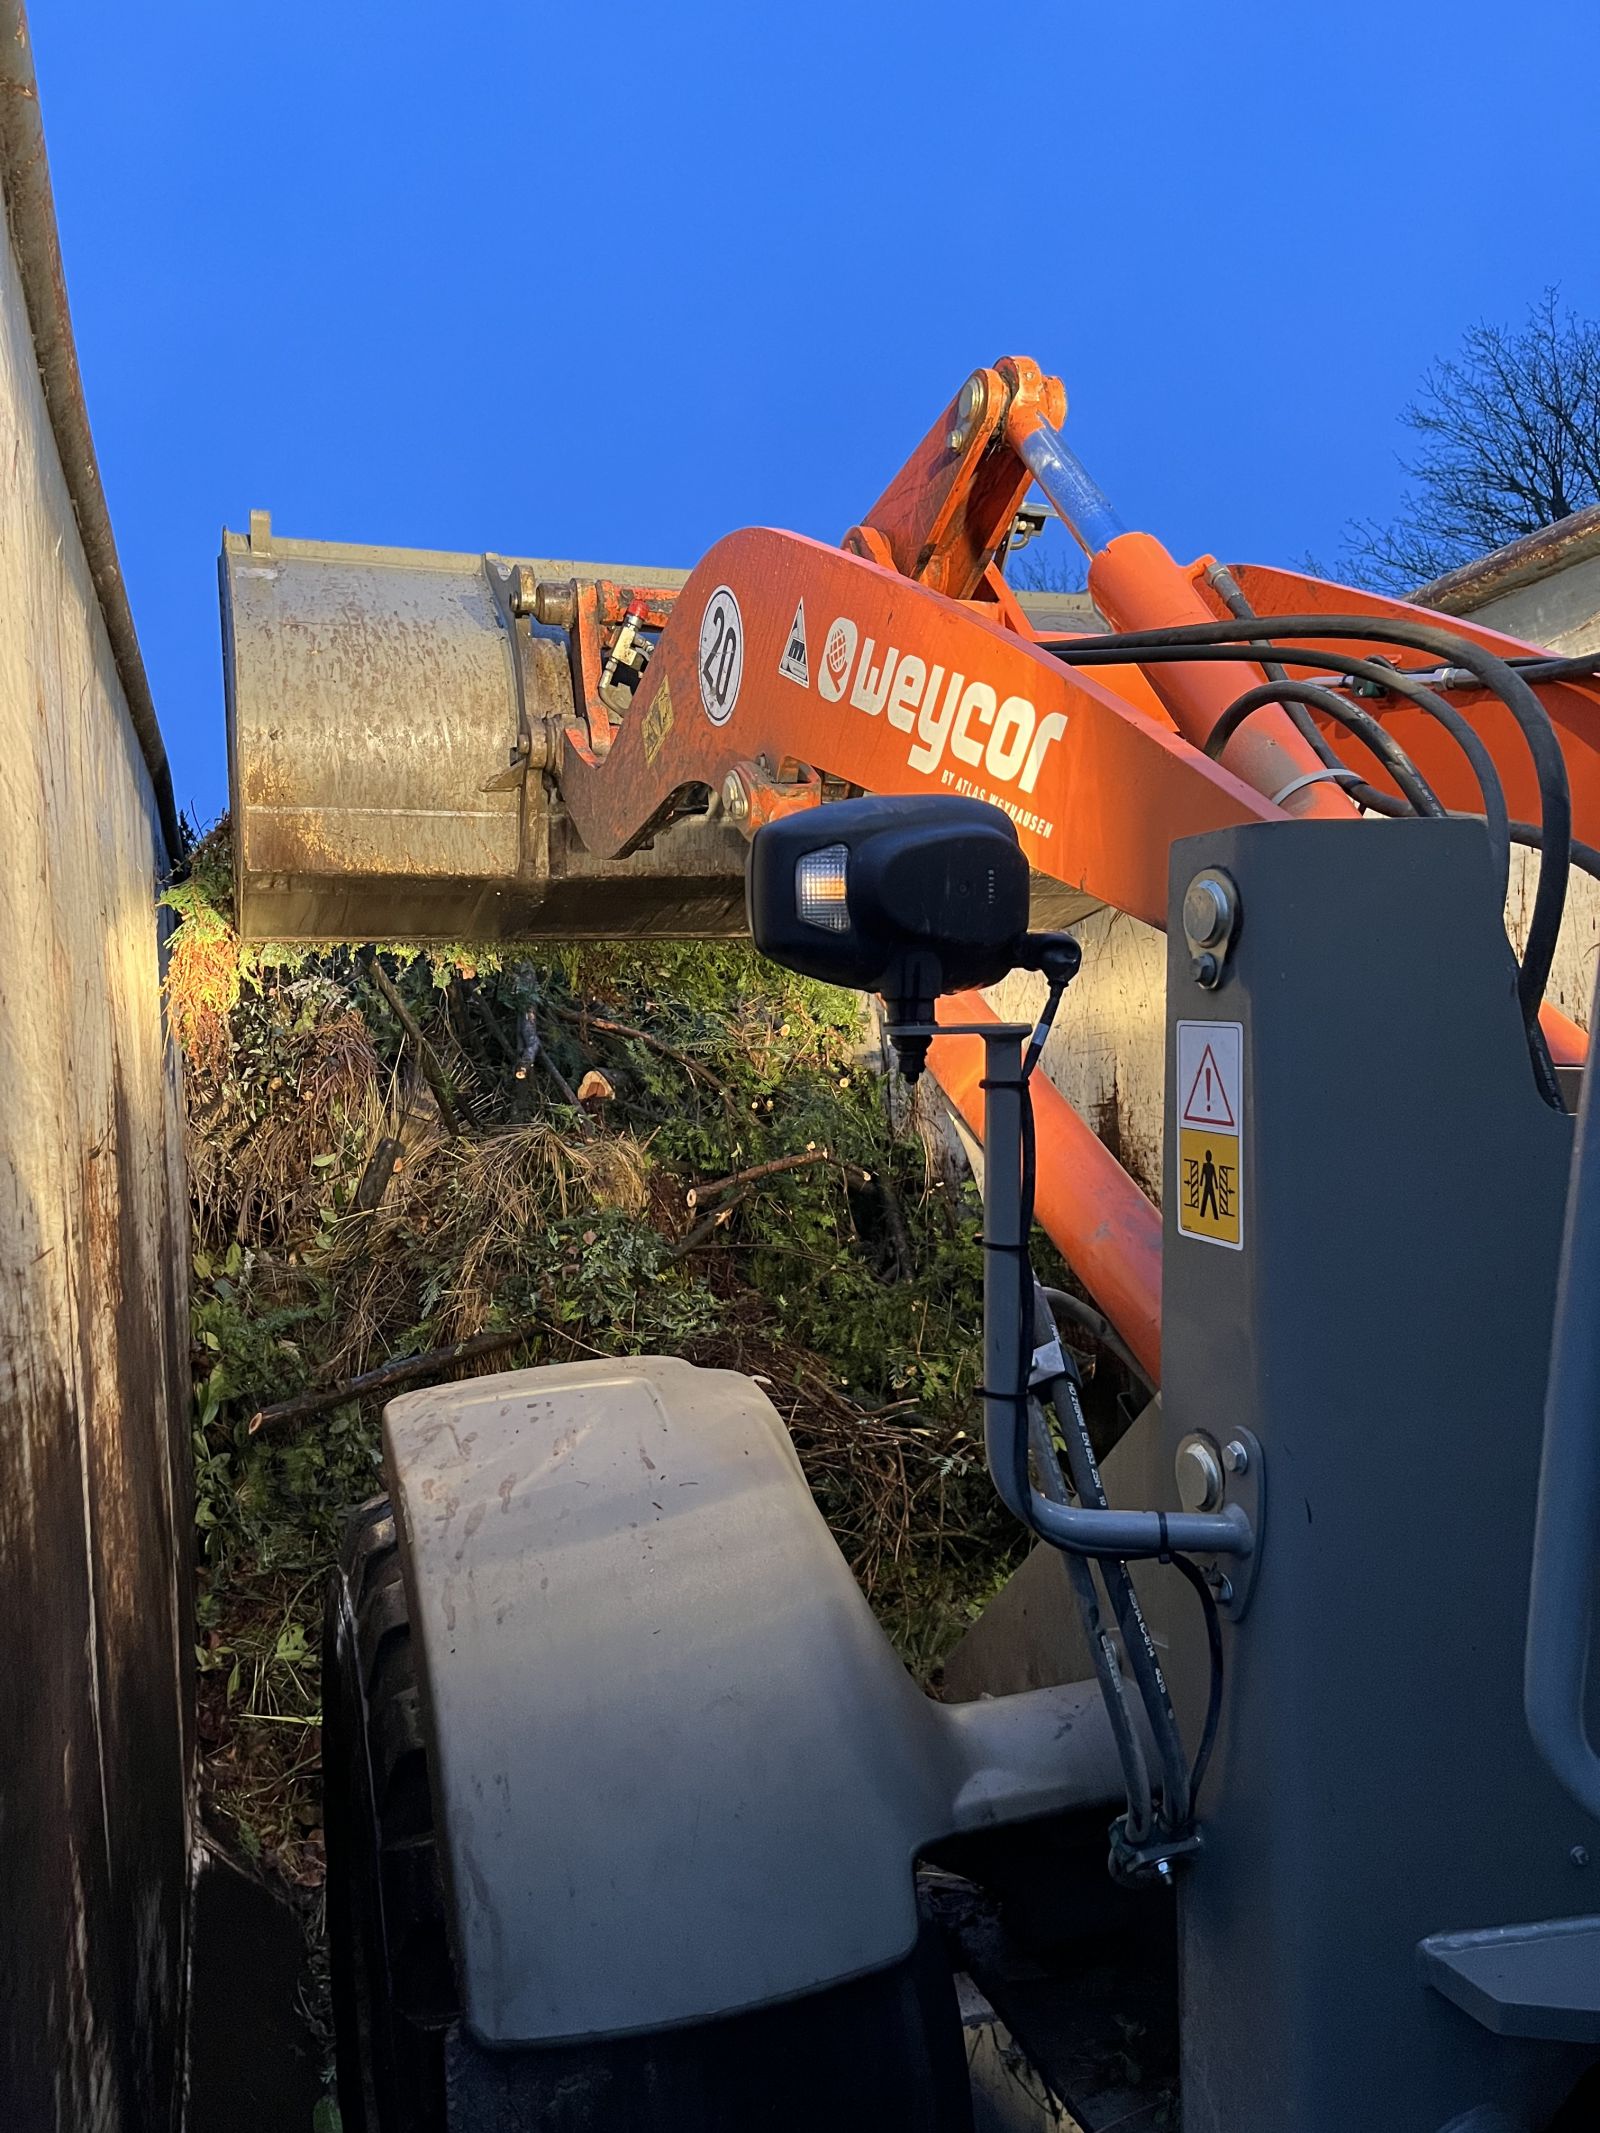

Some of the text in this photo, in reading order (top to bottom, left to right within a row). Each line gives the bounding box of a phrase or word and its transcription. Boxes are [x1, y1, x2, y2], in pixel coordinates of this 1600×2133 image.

[701, 606, 737, 707] 20
[849, 637, 1068, 794] weycor
[941, 769, 1053, 838] BY ATLAS WEYHAUSEN
